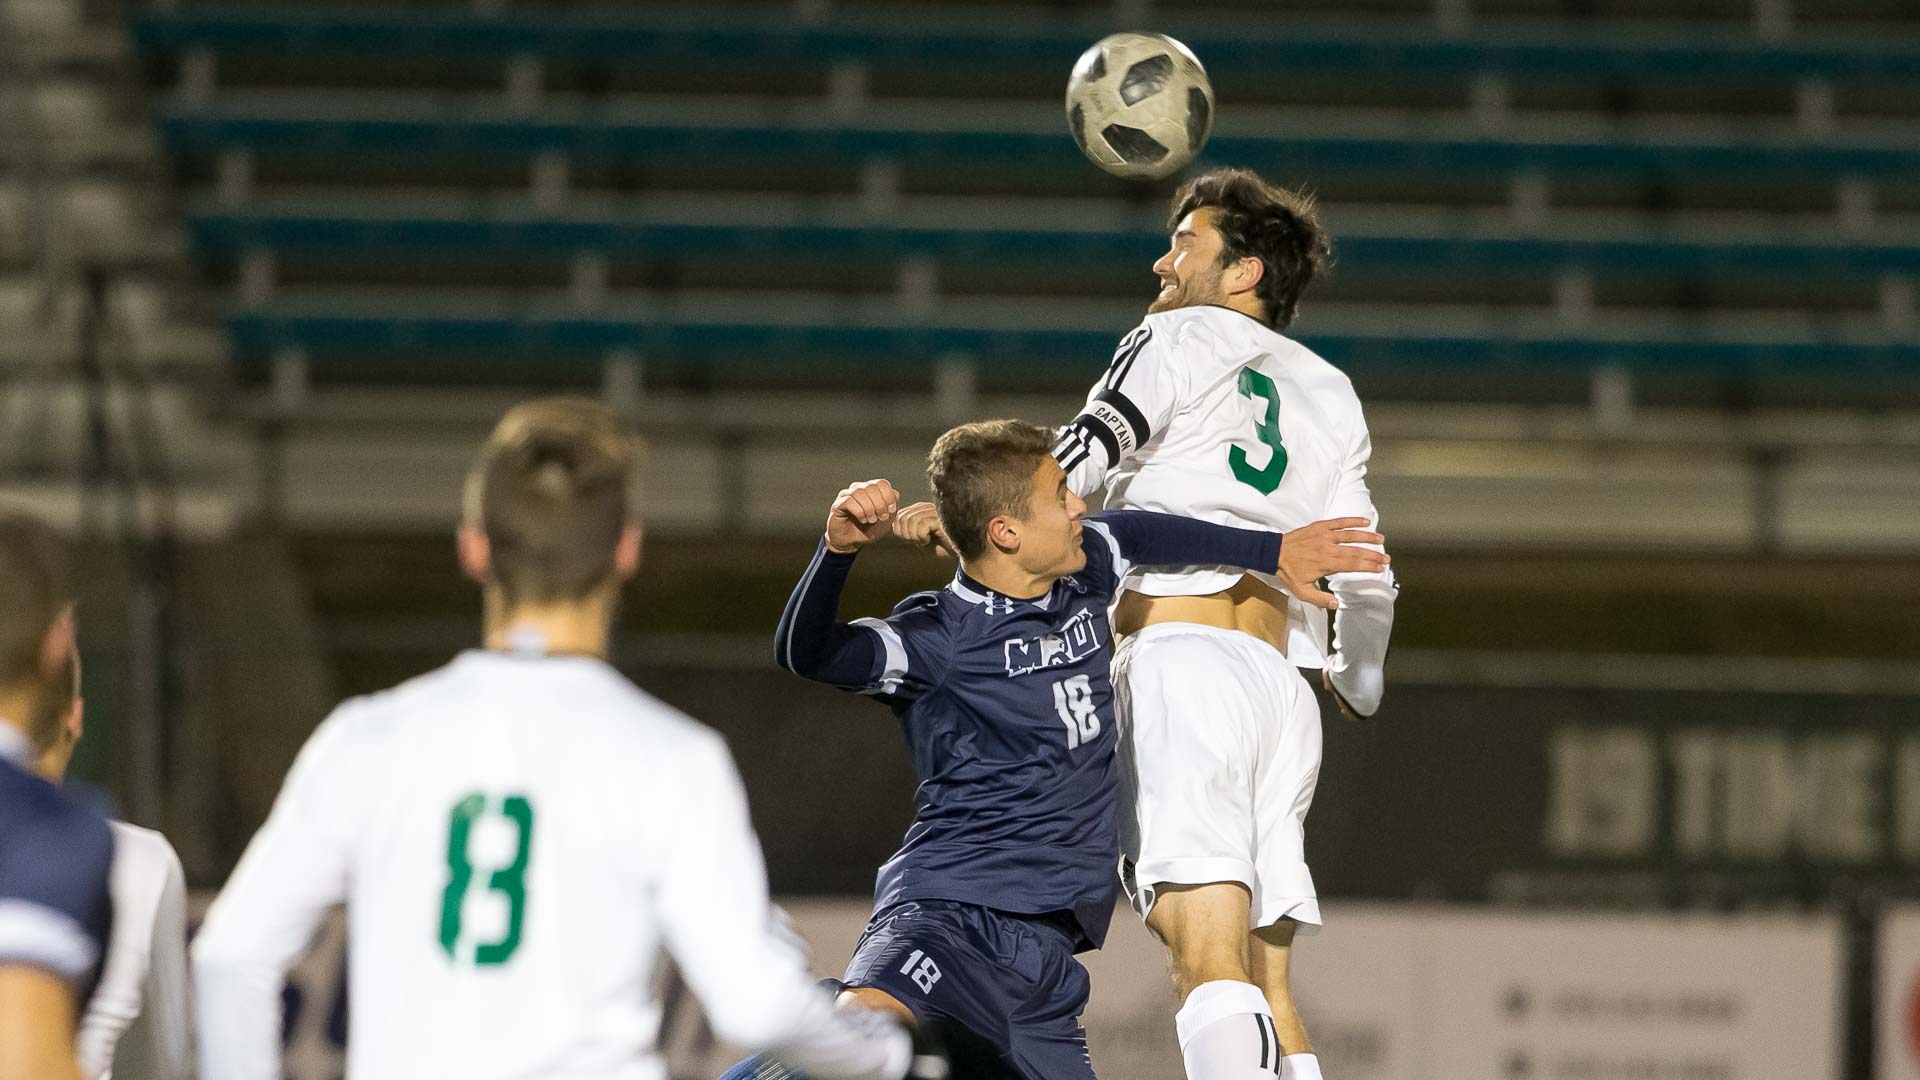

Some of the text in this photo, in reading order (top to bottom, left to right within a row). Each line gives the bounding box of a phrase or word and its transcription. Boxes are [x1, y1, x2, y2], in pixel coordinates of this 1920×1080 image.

[1094, 407, 1132, 451] CAPTAIN
[1228, 366, 1288, 496] 3
[1004, 607, 1101, 678] MRU
[1052, 674, 1101, 750] 18
[440, 793, 534, 964] 8
[899, 949, 942, 995] 18
